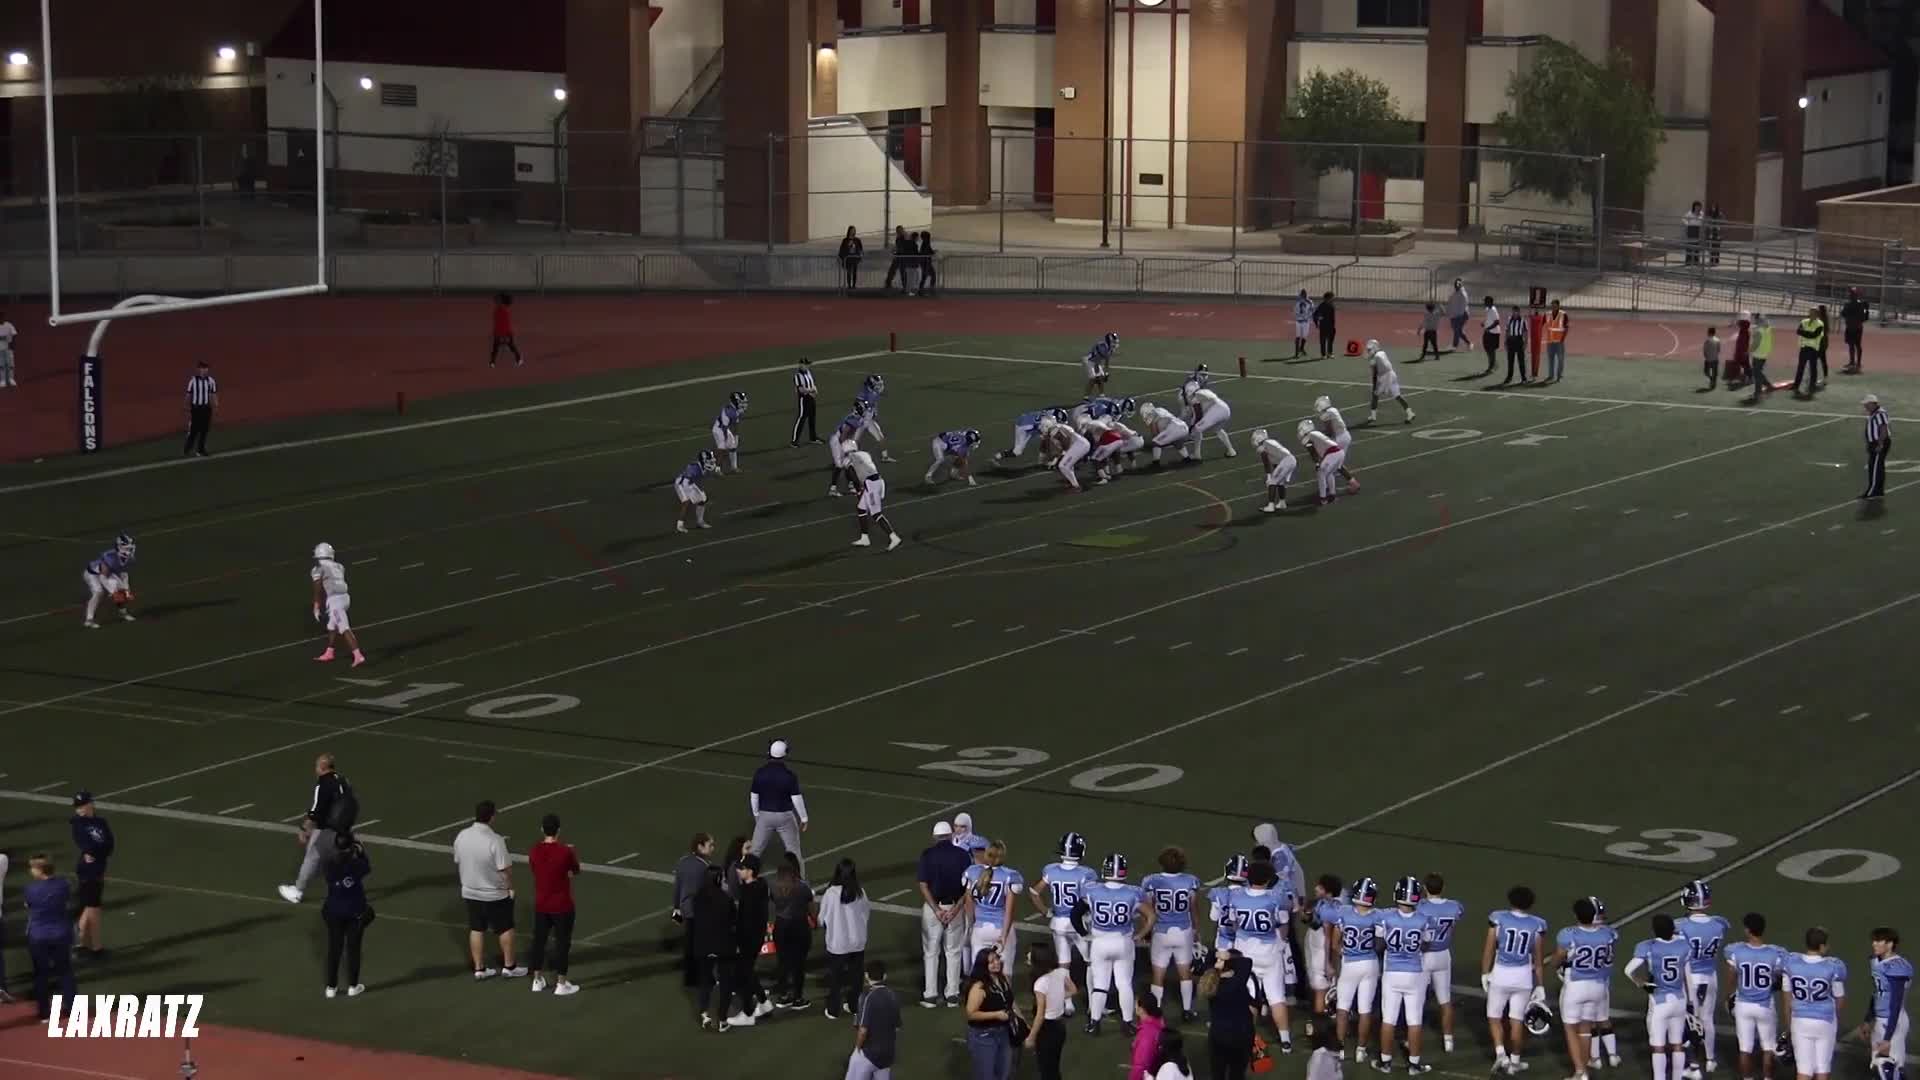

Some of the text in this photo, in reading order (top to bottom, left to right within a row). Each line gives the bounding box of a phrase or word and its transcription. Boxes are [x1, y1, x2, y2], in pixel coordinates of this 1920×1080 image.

[83, 362, 97, 450] FALCONS
[917, 746, 1184, 792] 20
[1604, 828, 1900, 883] 30
[1051, 880, 1080, 907] 15
[1155, 888, 1190, 914] 56
[1094, 900, 1130, 926] 58
[1236, 908, 1273, 934] 76
[1342, 924, 1377, 951] 32
[1386, 927, 1423, 953] 43
[1504, 927, 1531, 956] 11
[1690, 936, 1720, 960] 14
[1661, 955, 1681, 983] 5
[1740, 961, 1772, 989] 16
[1790, 975, 1830, 1002] 62
